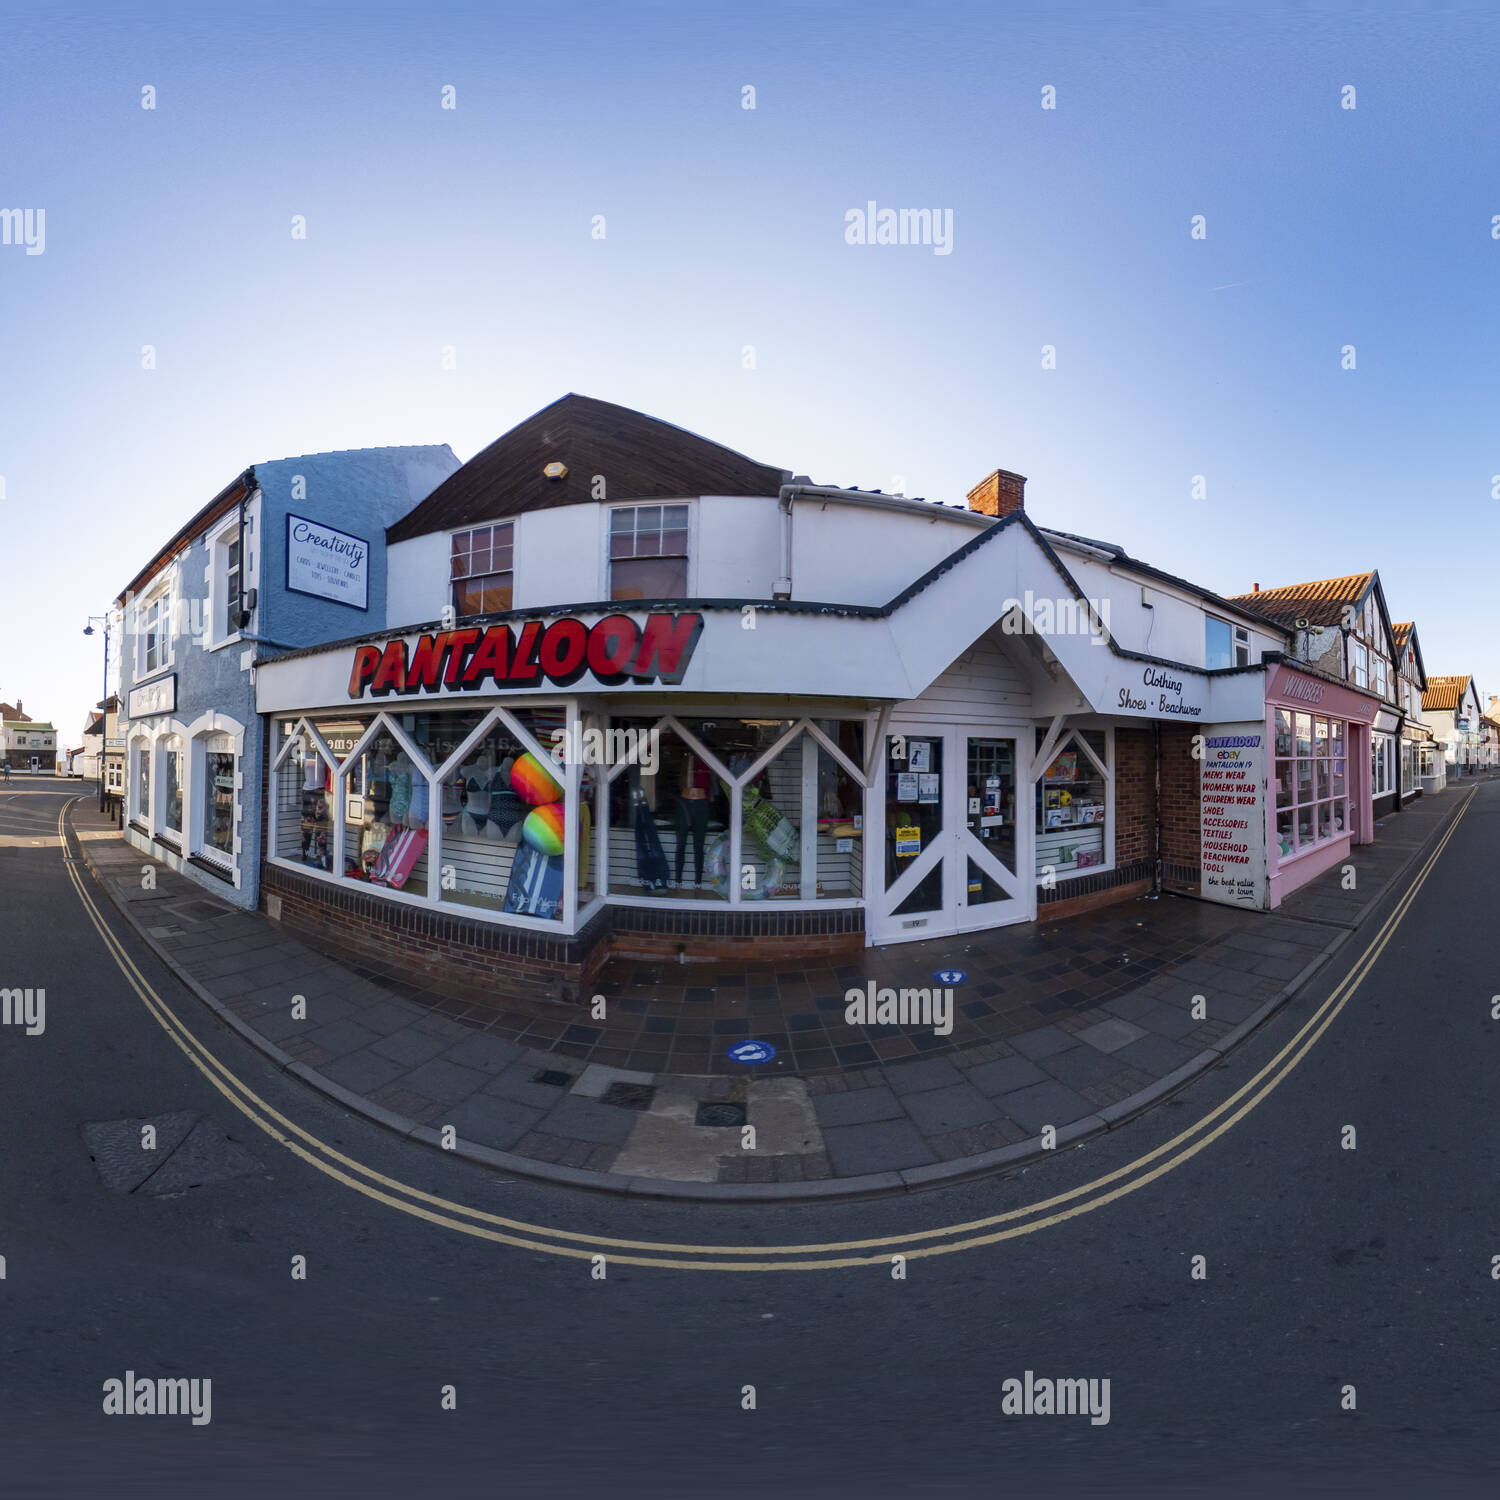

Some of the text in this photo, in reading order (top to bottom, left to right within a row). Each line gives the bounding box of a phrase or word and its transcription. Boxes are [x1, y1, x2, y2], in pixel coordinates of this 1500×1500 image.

[293, 522, 364, 568] Creativity
[349, 612, 704, 699] PANTALOON
[1143, 667, 1182, 695] Clothing
[1282, 675, 1326, 704] WINIBEES
[1118, 688, 1202, 716] Shoes Beachwear
[1203, 735, 1261, 749] PANTALOON
[1217, 750, 1241, 760] ebay
[1205, 760, 1253, 769] PANTALOON 19
[1202, 771, 1246, 780] MENS WEAR
[1202, 783, 1256, 793] WOMENS WEAR
[1202, 795, 1256, 806] CHILDRENS WEAR
[1203, 806, 1224, 816] SHOES
[1203, 818, 1248, 829] ACCESSORIES
[1203, 829, 1233, 840] TEXTILES
[1203, 841, 1248, 853] HOUSEHOLD
[1203, 852, 1250, 864] BEACHWEAR
[1203, 863, 1224, 873] TOOLS
[1208, 876, 1255, 887] the best value
[1228, 886, 1254, 896] in town
